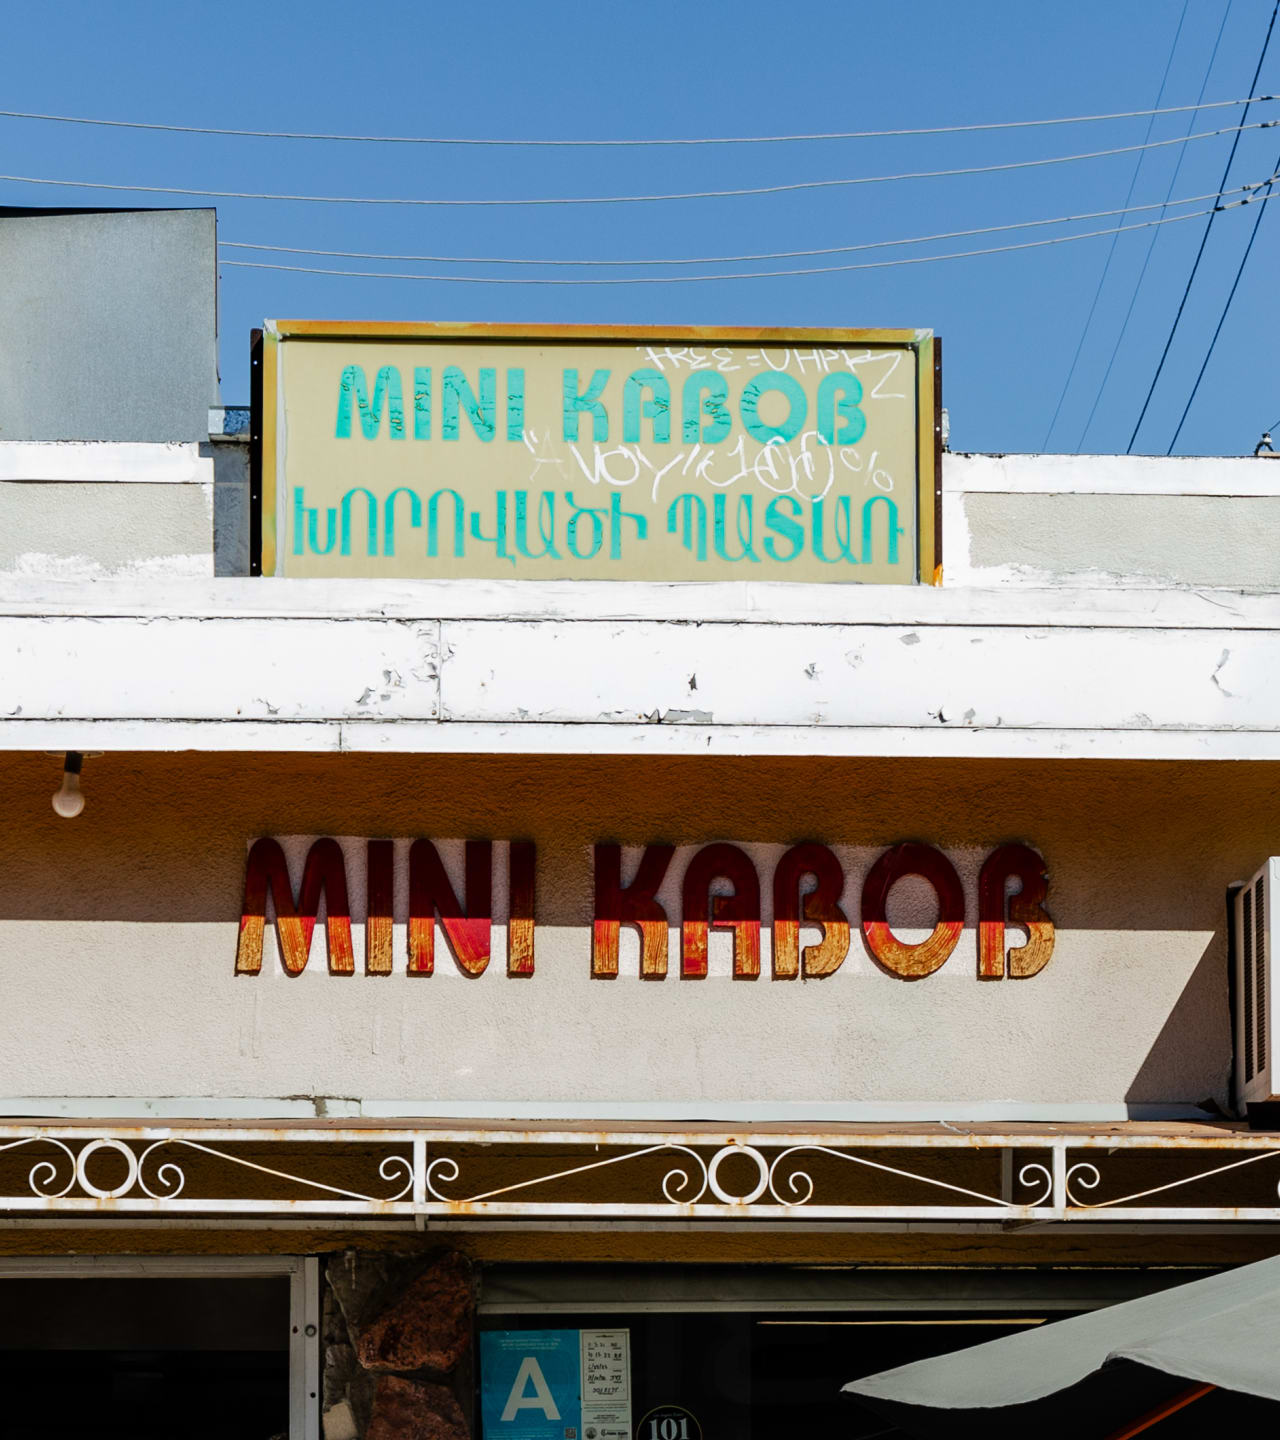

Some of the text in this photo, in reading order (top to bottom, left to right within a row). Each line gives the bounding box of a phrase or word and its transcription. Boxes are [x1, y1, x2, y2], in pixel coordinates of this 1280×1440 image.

[335, 365, 867, 446] MINI KABOB
[235, 837, 1056, 983] MINI KABOB
[500, 1357, 562, 1422] A
[647, 1418, 690, 1440] 101
